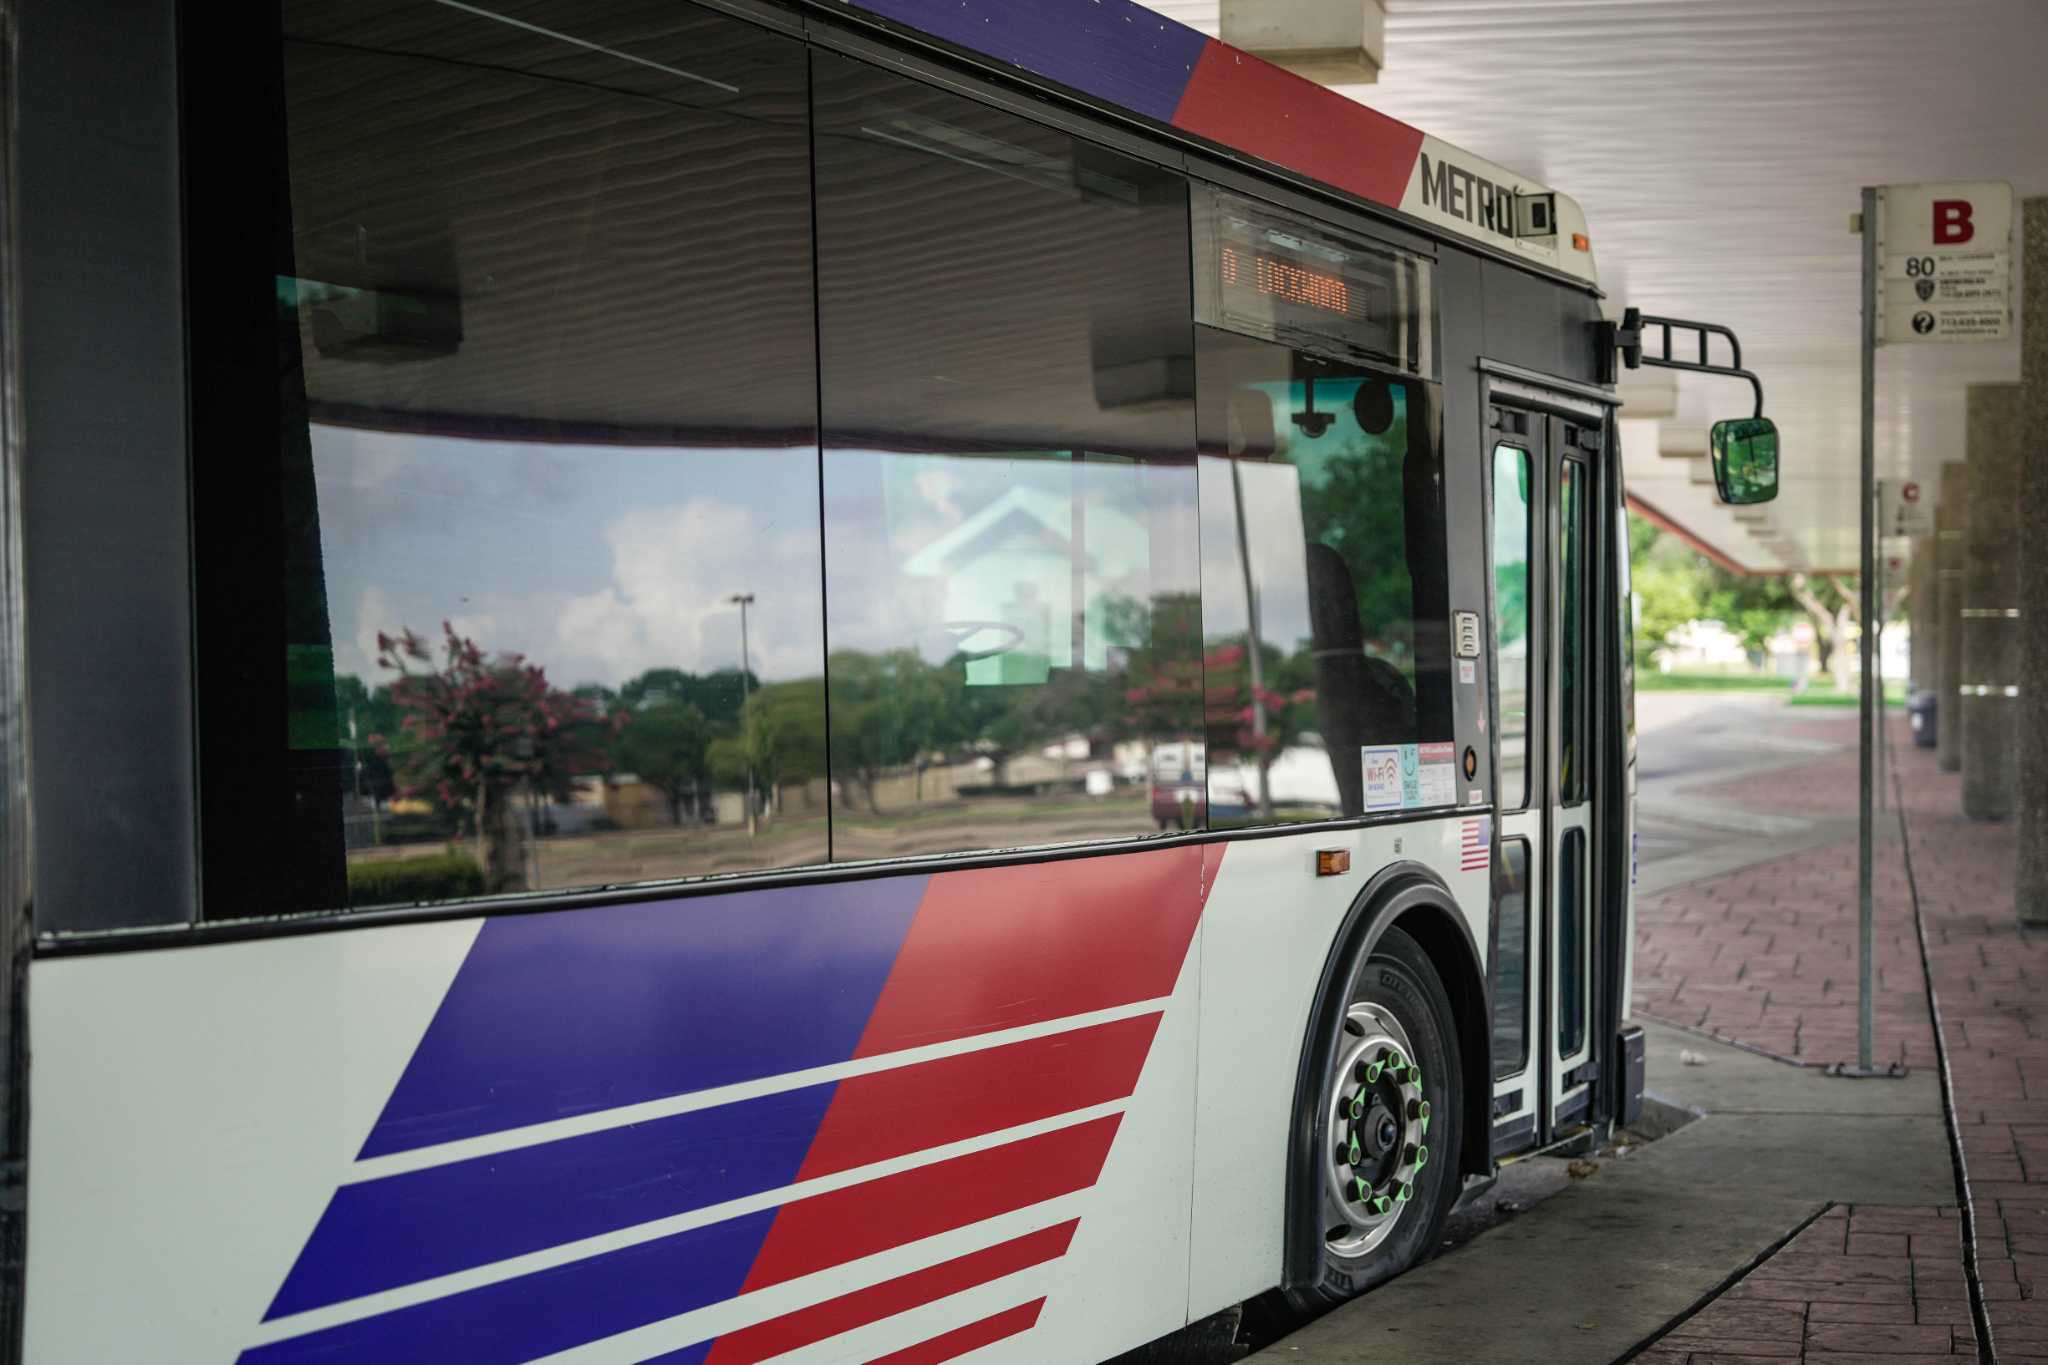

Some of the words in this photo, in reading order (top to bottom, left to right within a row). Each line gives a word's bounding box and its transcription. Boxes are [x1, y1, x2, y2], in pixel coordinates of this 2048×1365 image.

[1421, 152, 1514, 238] METRO
[1932, 199, 1975, 245] B
[1906, 257, 1935, 277] 80
